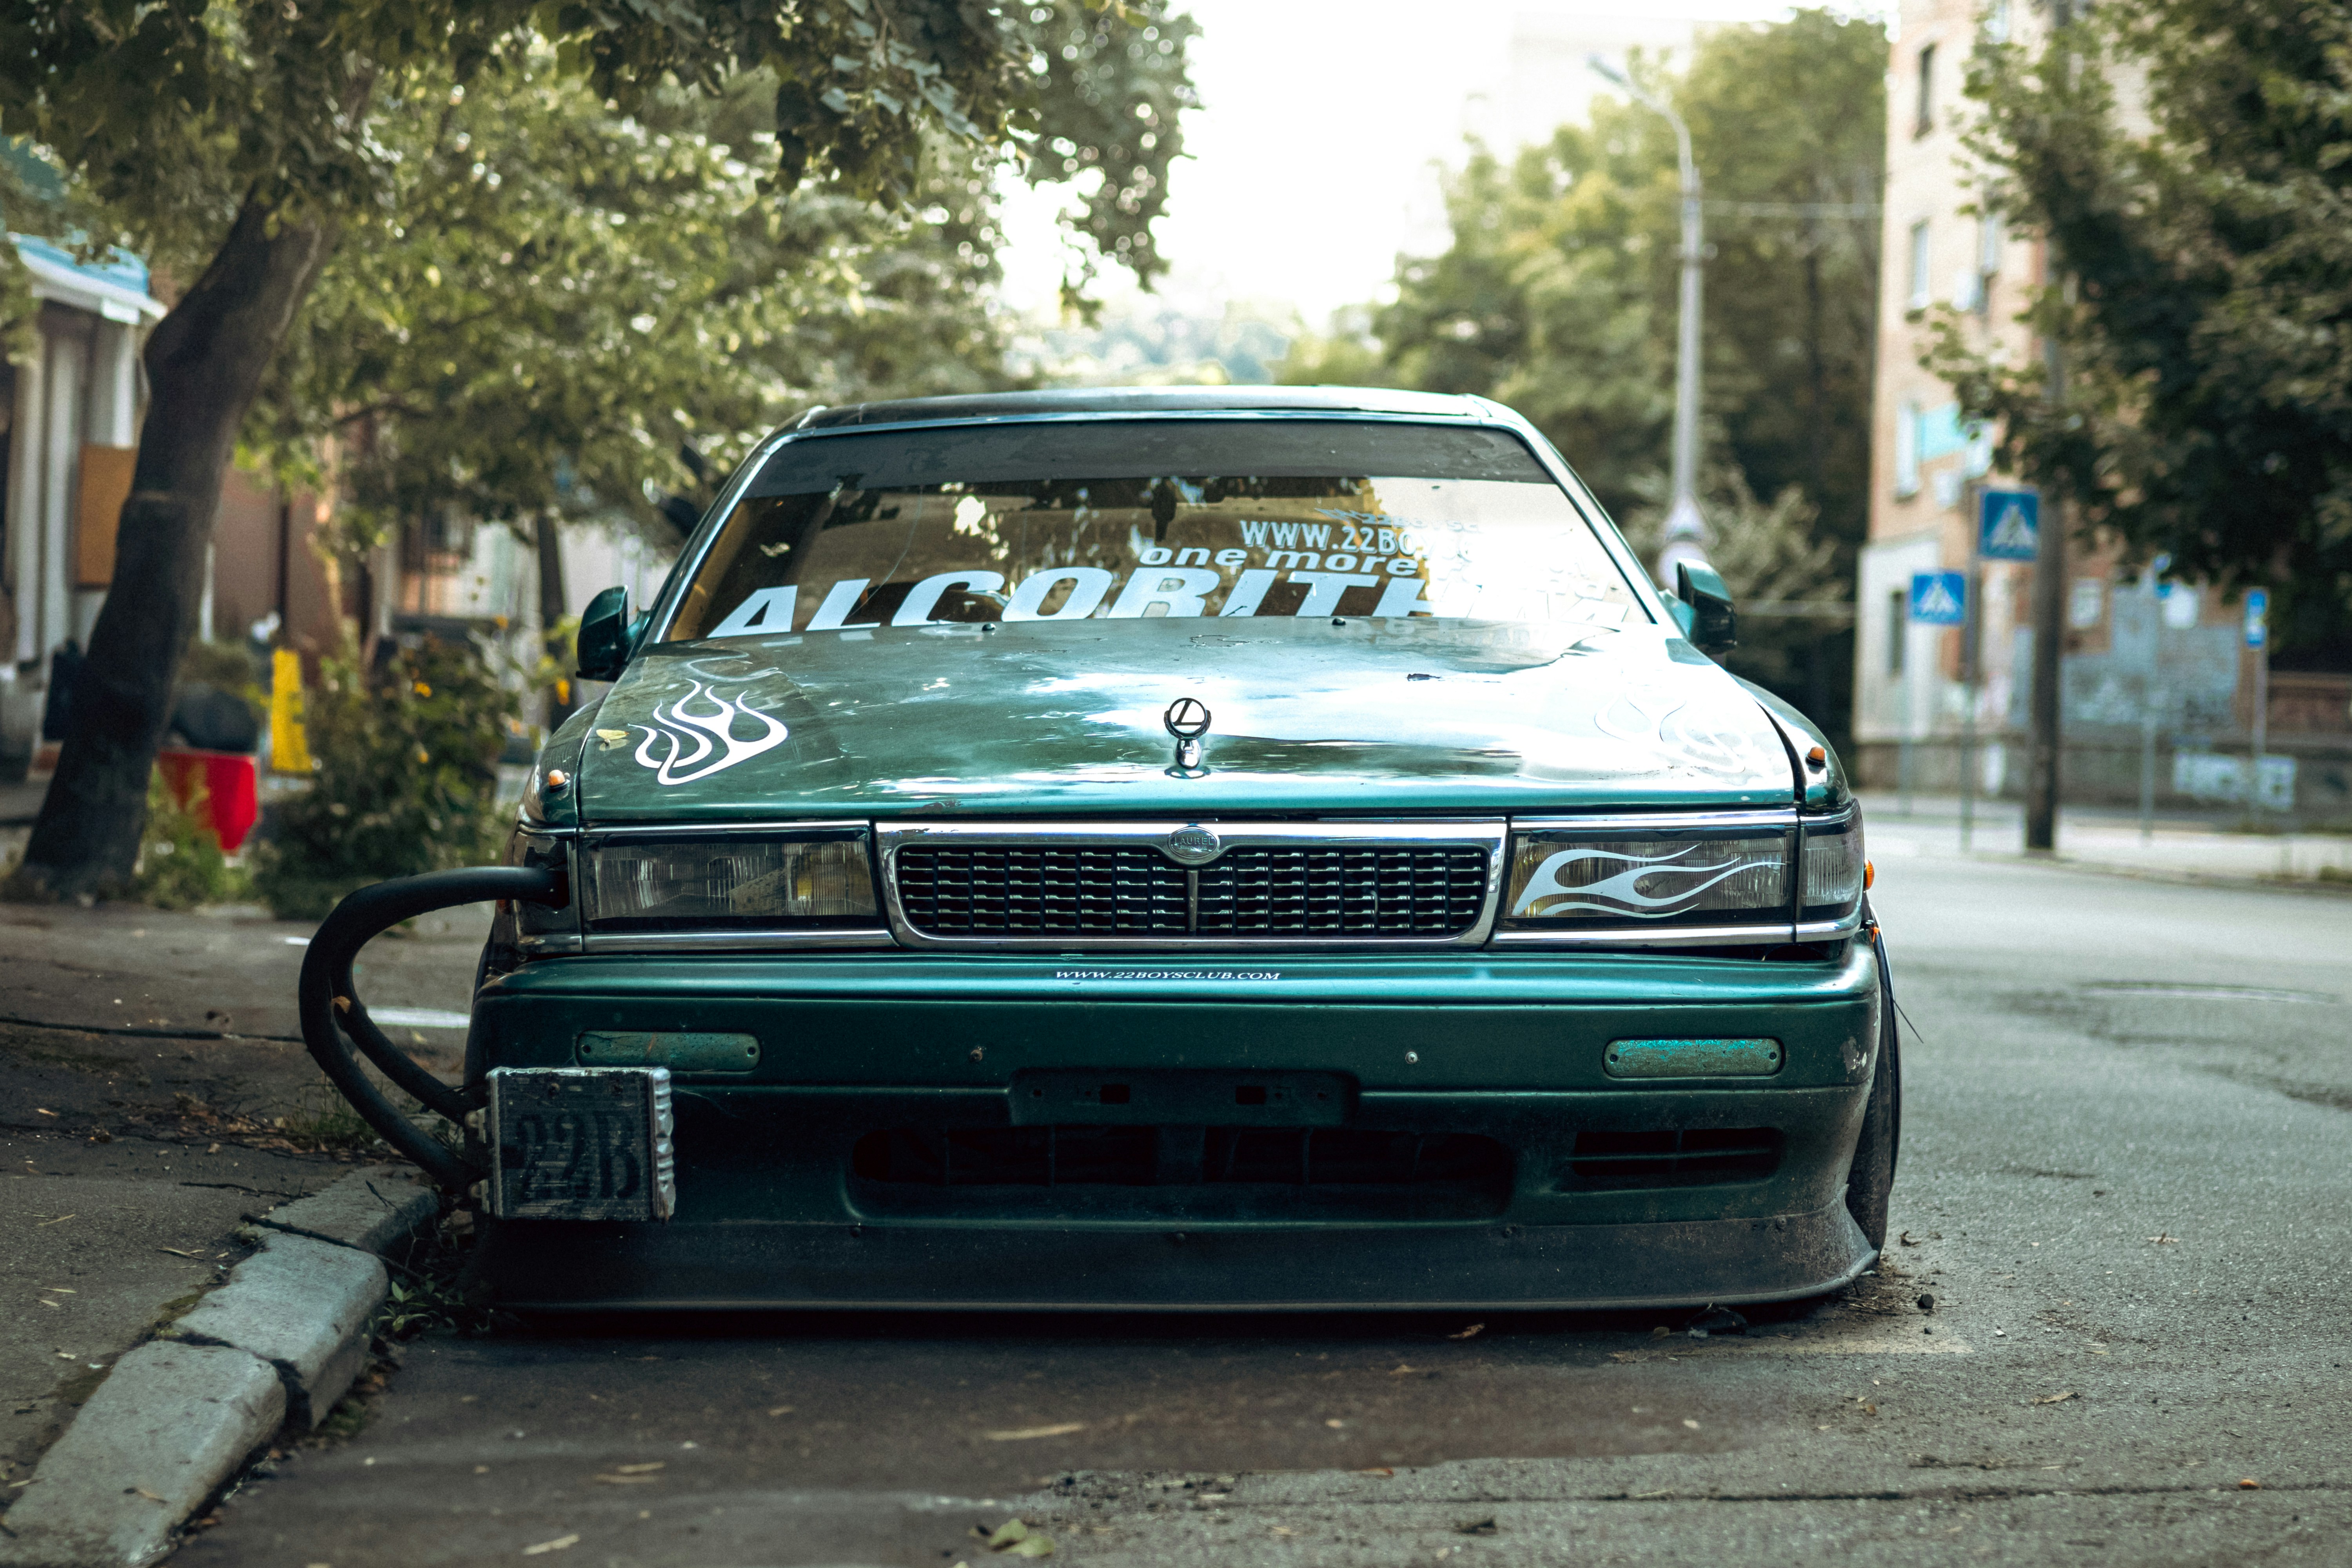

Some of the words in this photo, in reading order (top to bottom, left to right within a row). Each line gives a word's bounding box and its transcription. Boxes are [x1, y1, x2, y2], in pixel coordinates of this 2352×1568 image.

[1139, 547, 1248, 566] one
[1265, 550, 1419, 576] more
[1175, 837, 1214, 845] LAUREL
[1056, 971, 1281, 980] WWW.22BOYSCLUB.COM
